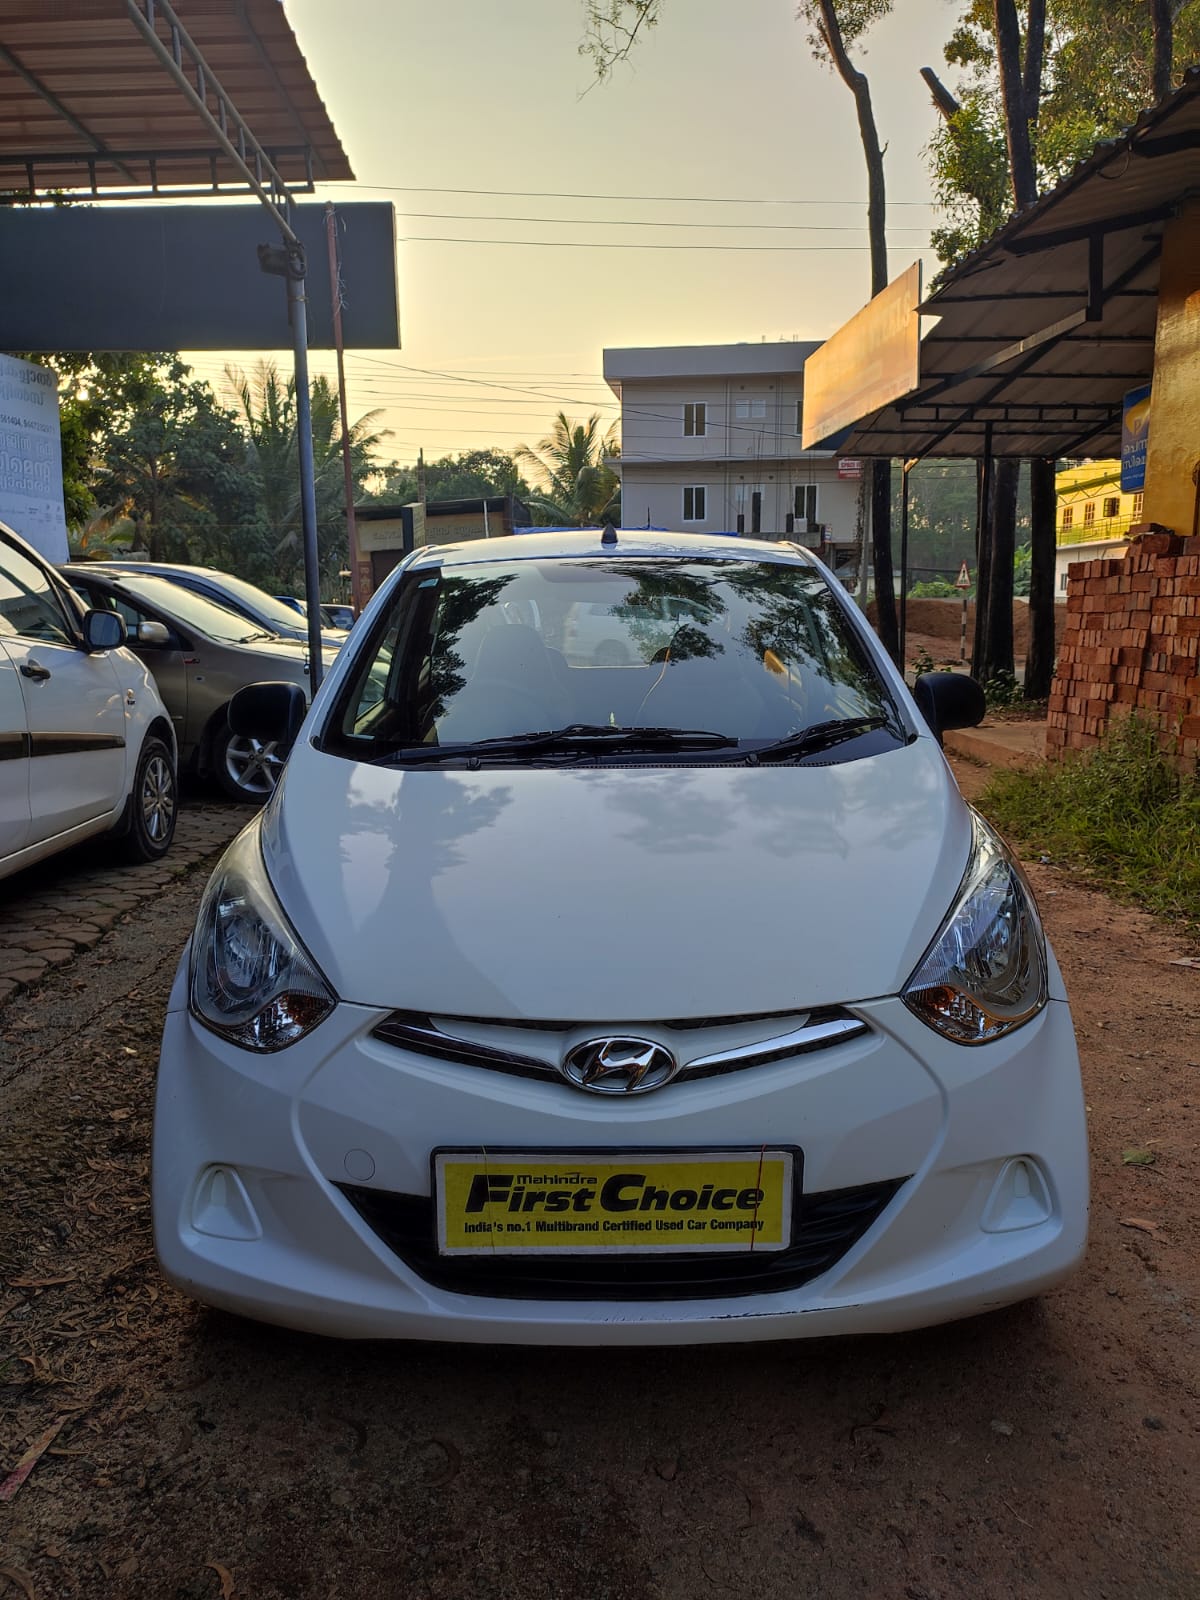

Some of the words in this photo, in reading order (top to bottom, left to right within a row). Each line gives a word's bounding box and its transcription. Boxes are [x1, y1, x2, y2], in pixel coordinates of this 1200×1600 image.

[517, 1172, 598, 1184] Mahindra
[465, 1174, 596, 1212] First
[600, 1174, 765, 1212] Choice
[464, 1221, 504, 1233] India's
[506, 1222, 532, 1232] no.1
[535, 1220, 600, 1232] Multibrand
[602, 1220, 652, 1231] Certified
[655, 1219, 684, 1230] Used
[687, 1219, 708, 1230] Car
[710, 1218, 764, 1231] Company
